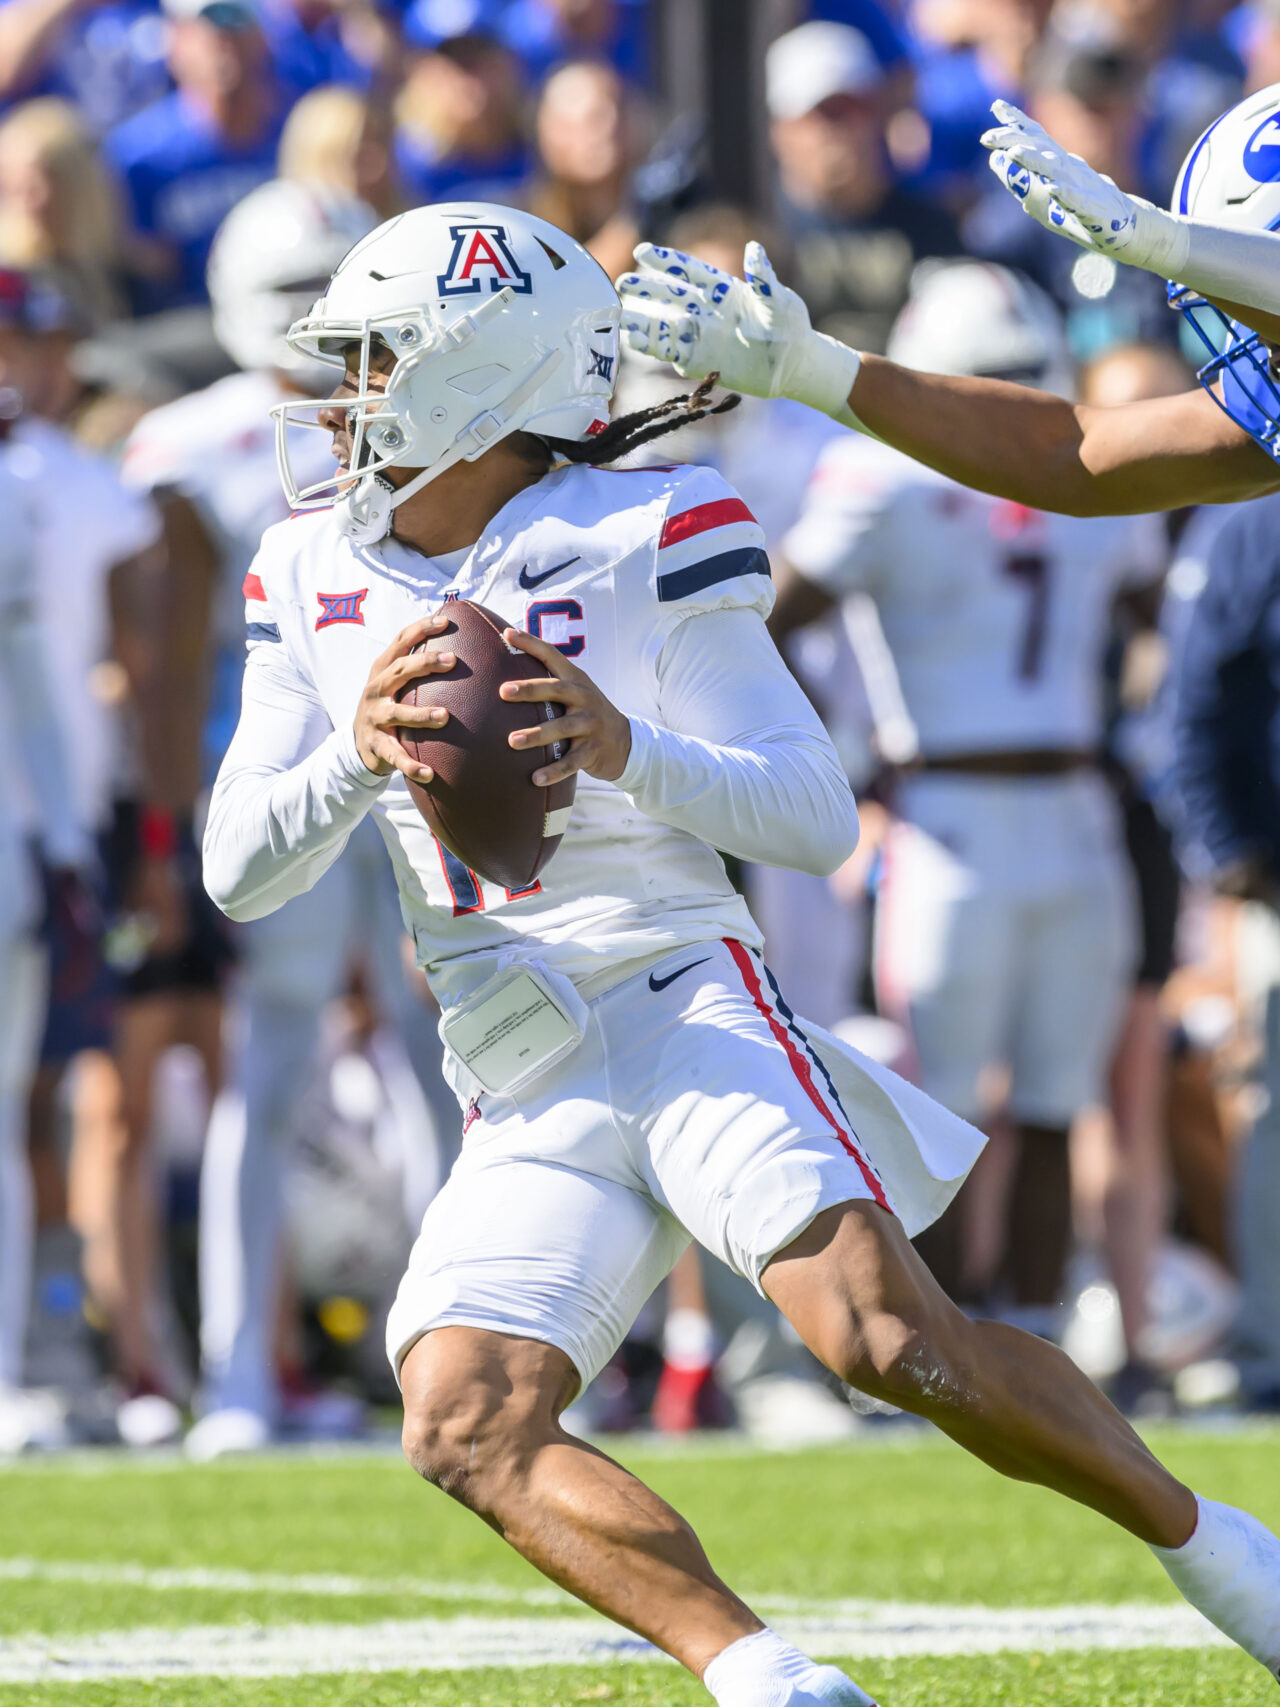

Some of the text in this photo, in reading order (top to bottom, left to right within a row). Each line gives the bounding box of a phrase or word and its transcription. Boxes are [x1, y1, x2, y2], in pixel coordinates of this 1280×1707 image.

[437, 224, 532, 297] A
[587, 347, 614, 383] XII
[316, 591, 364, 628] XII
[526, 598, 586, 658] C
